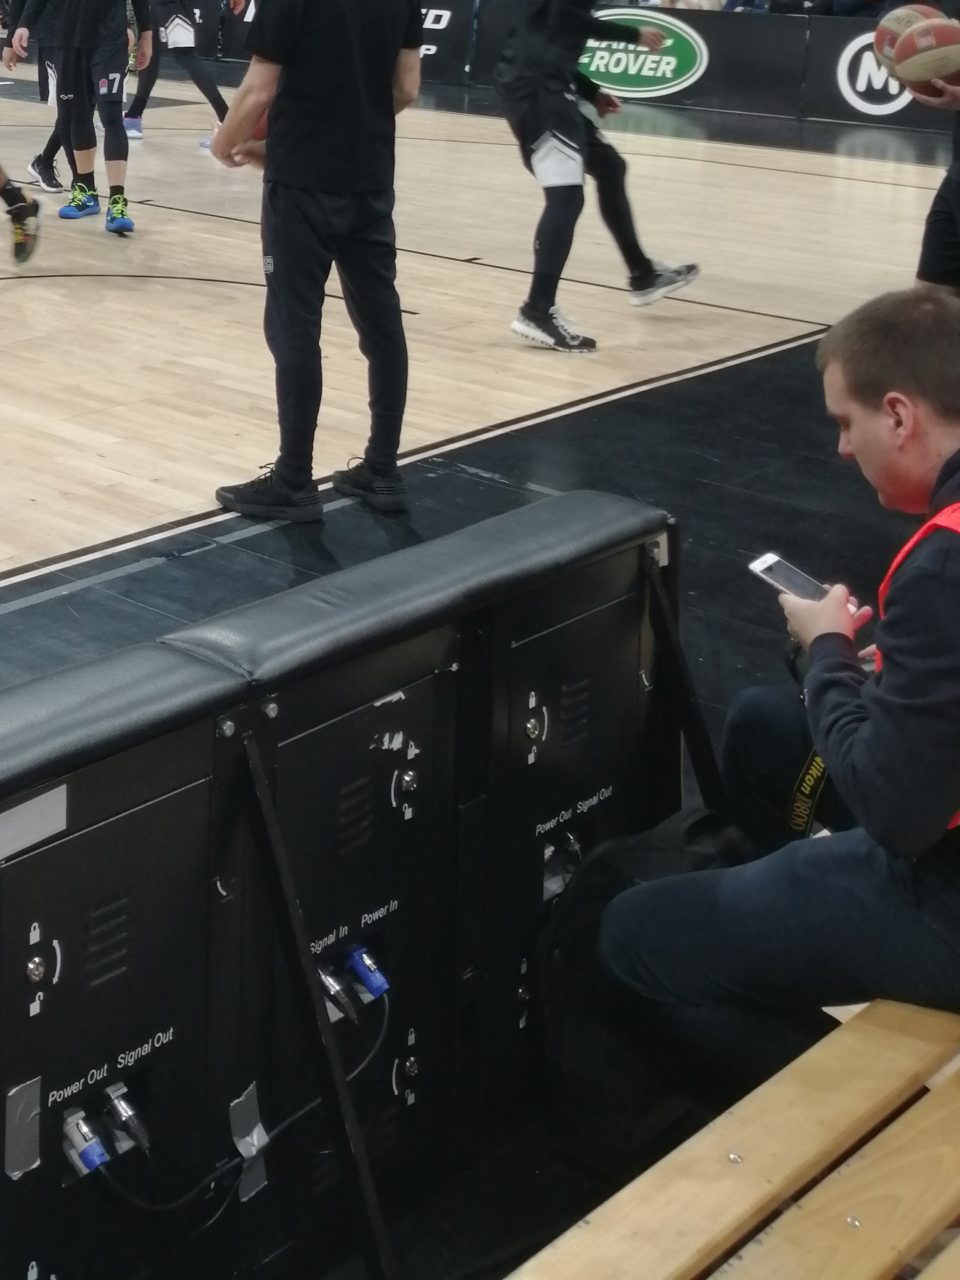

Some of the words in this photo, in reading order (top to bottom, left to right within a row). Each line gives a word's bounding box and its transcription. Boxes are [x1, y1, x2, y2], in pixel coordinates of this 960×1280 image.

[589, 50, 677, 78] ROVER
[108, 72, 121, 94] 7
[535, 817, 558, 837] Power
[361, 904, 389, 928] Power
[389, 899, 398, 913] In
[339, 926, 348, 938] In
[117, 1037, 151, 1070] Signal
[153, 1025, 175, 1053] Out
[48, 1077, 85, 1108] Power
[87, 1062, 108, 1088] Out
